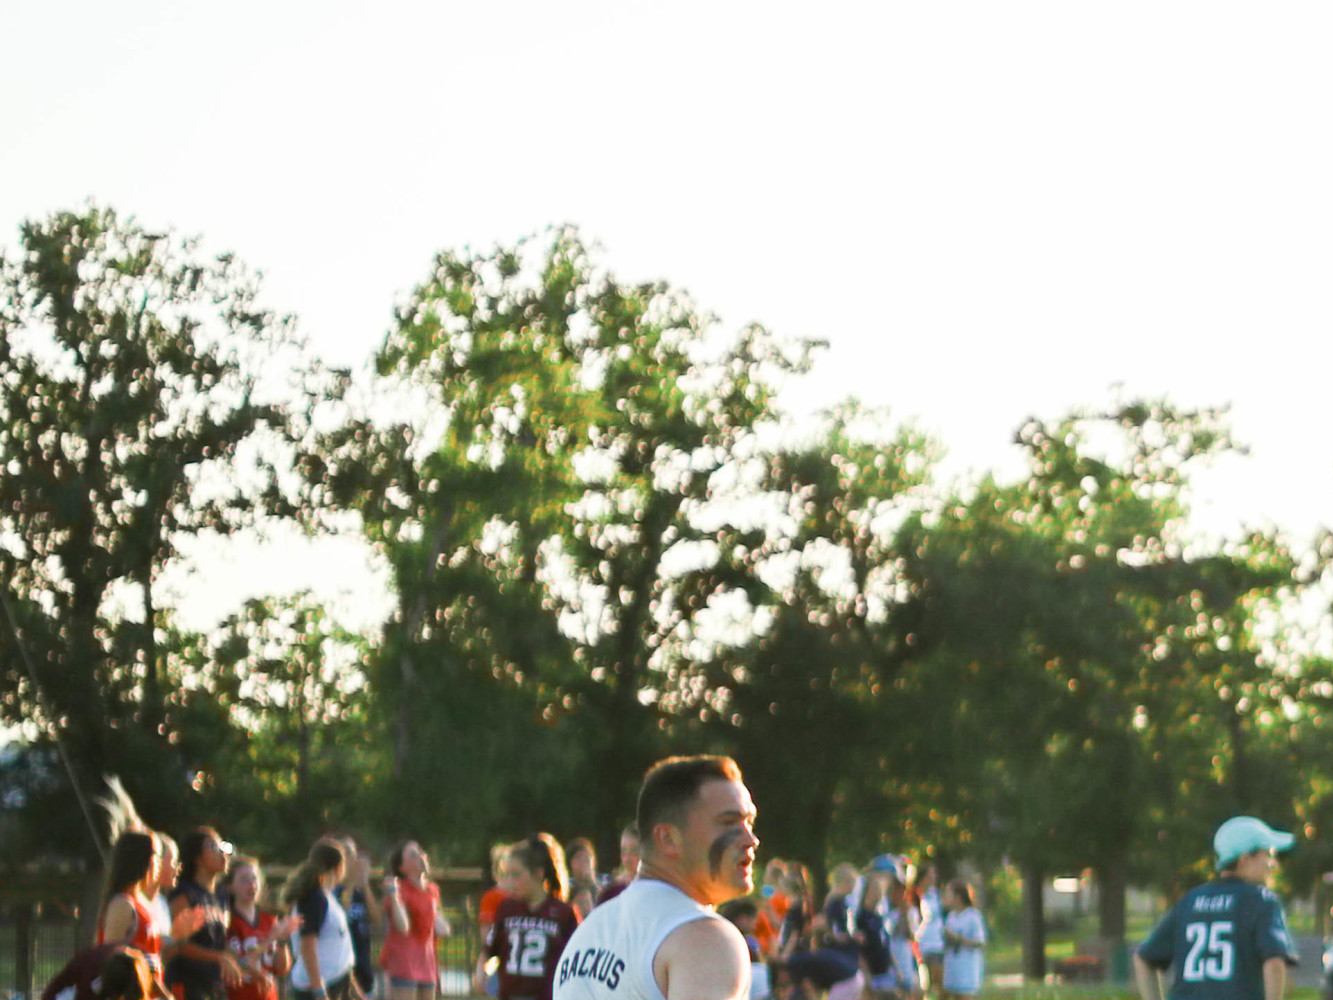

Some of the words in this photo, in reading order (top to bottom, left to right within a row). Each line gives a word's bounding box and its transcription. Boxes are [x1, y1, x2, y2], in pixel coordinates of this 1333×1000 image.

[506, 929, 546, 976] 12
[559, 948, 625, 990] BACKUS
[1183, 921, 1235, 982] 25
